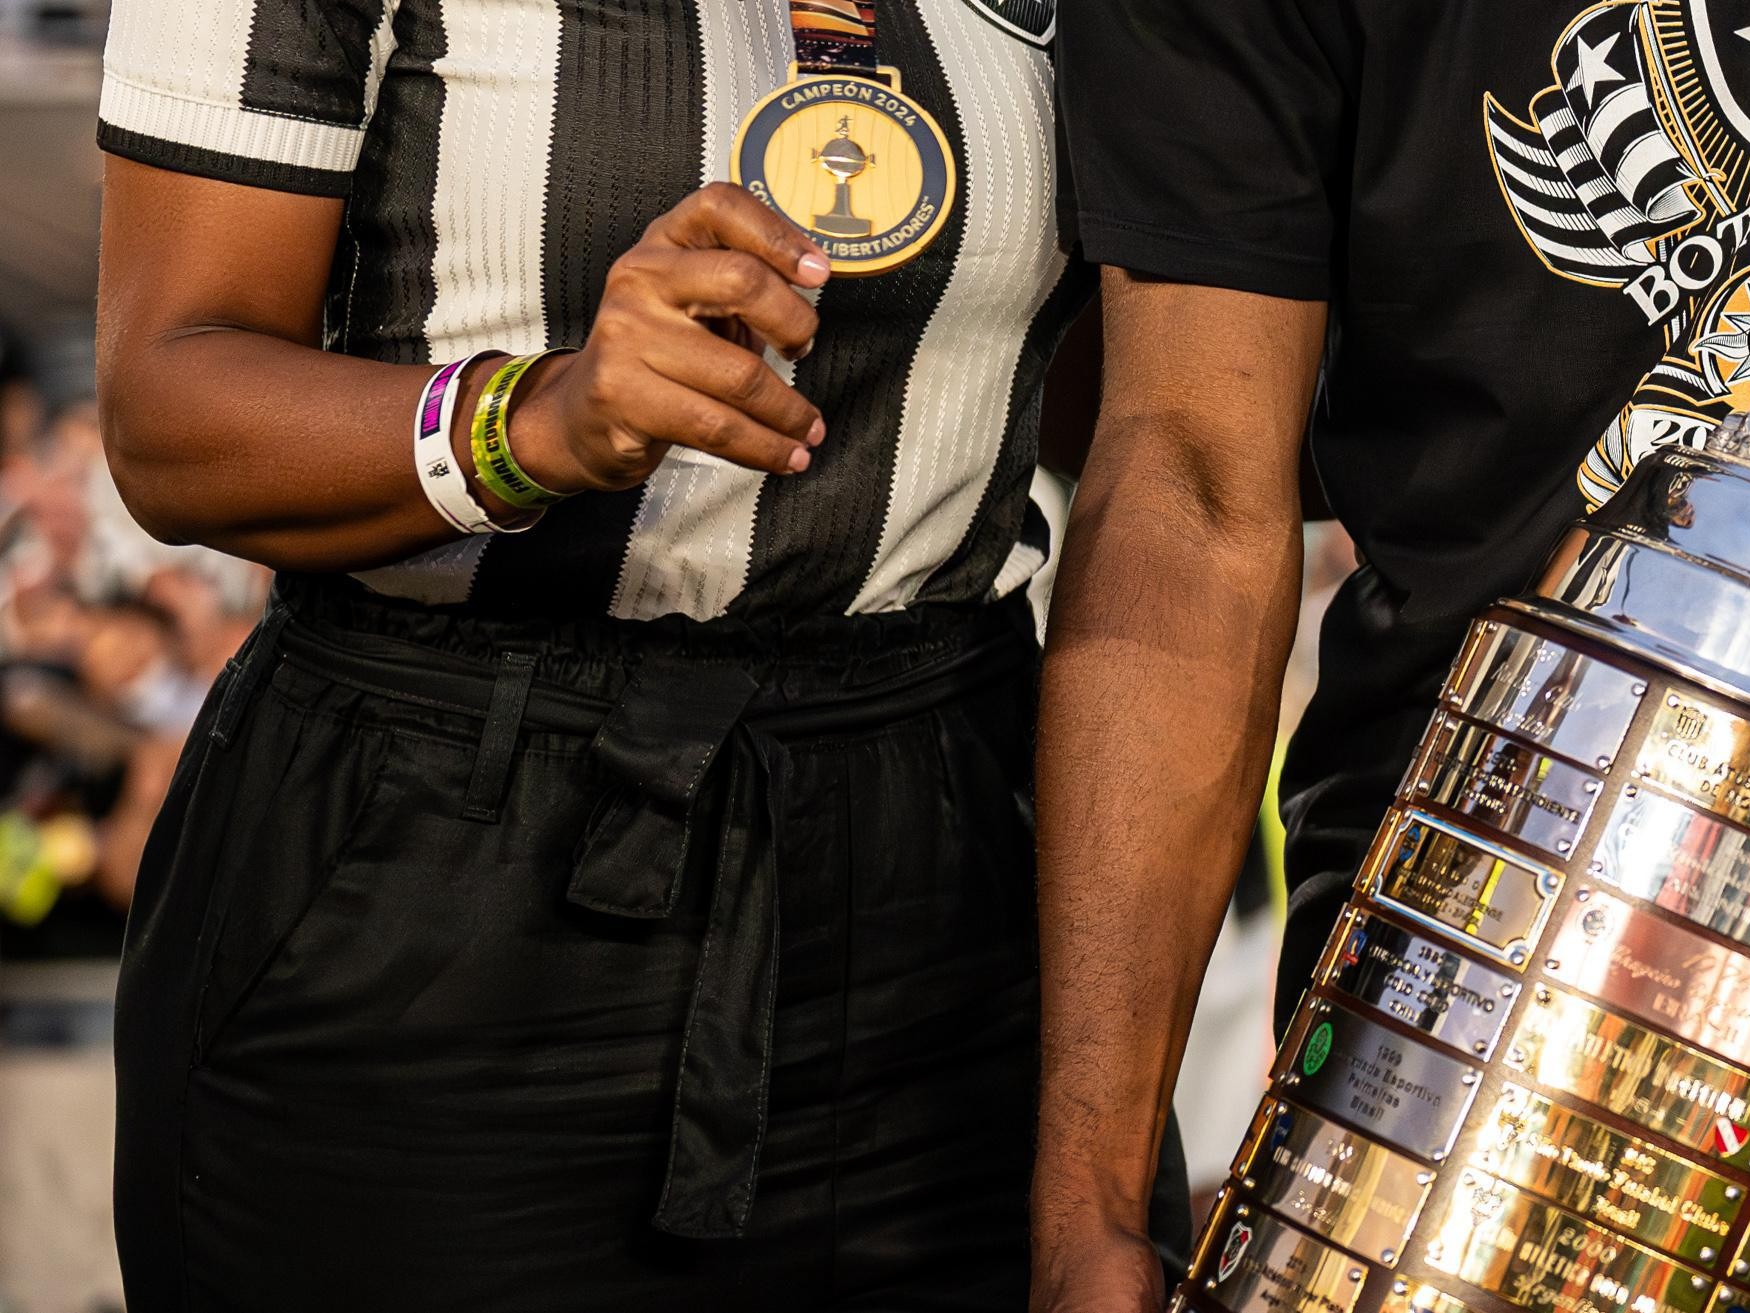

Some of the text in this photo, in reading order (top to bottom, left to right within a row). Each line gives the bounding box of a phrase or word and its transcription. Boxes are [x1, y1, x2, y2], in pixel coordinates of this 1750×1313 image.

[780, 82, 918, 128] CAMPEÓN 2024
[822, 201, 936, 256] LIBERTADORES
[491, 454, 531, 494] FINAL
[1559, 1226, 1617, 1264] 2000
